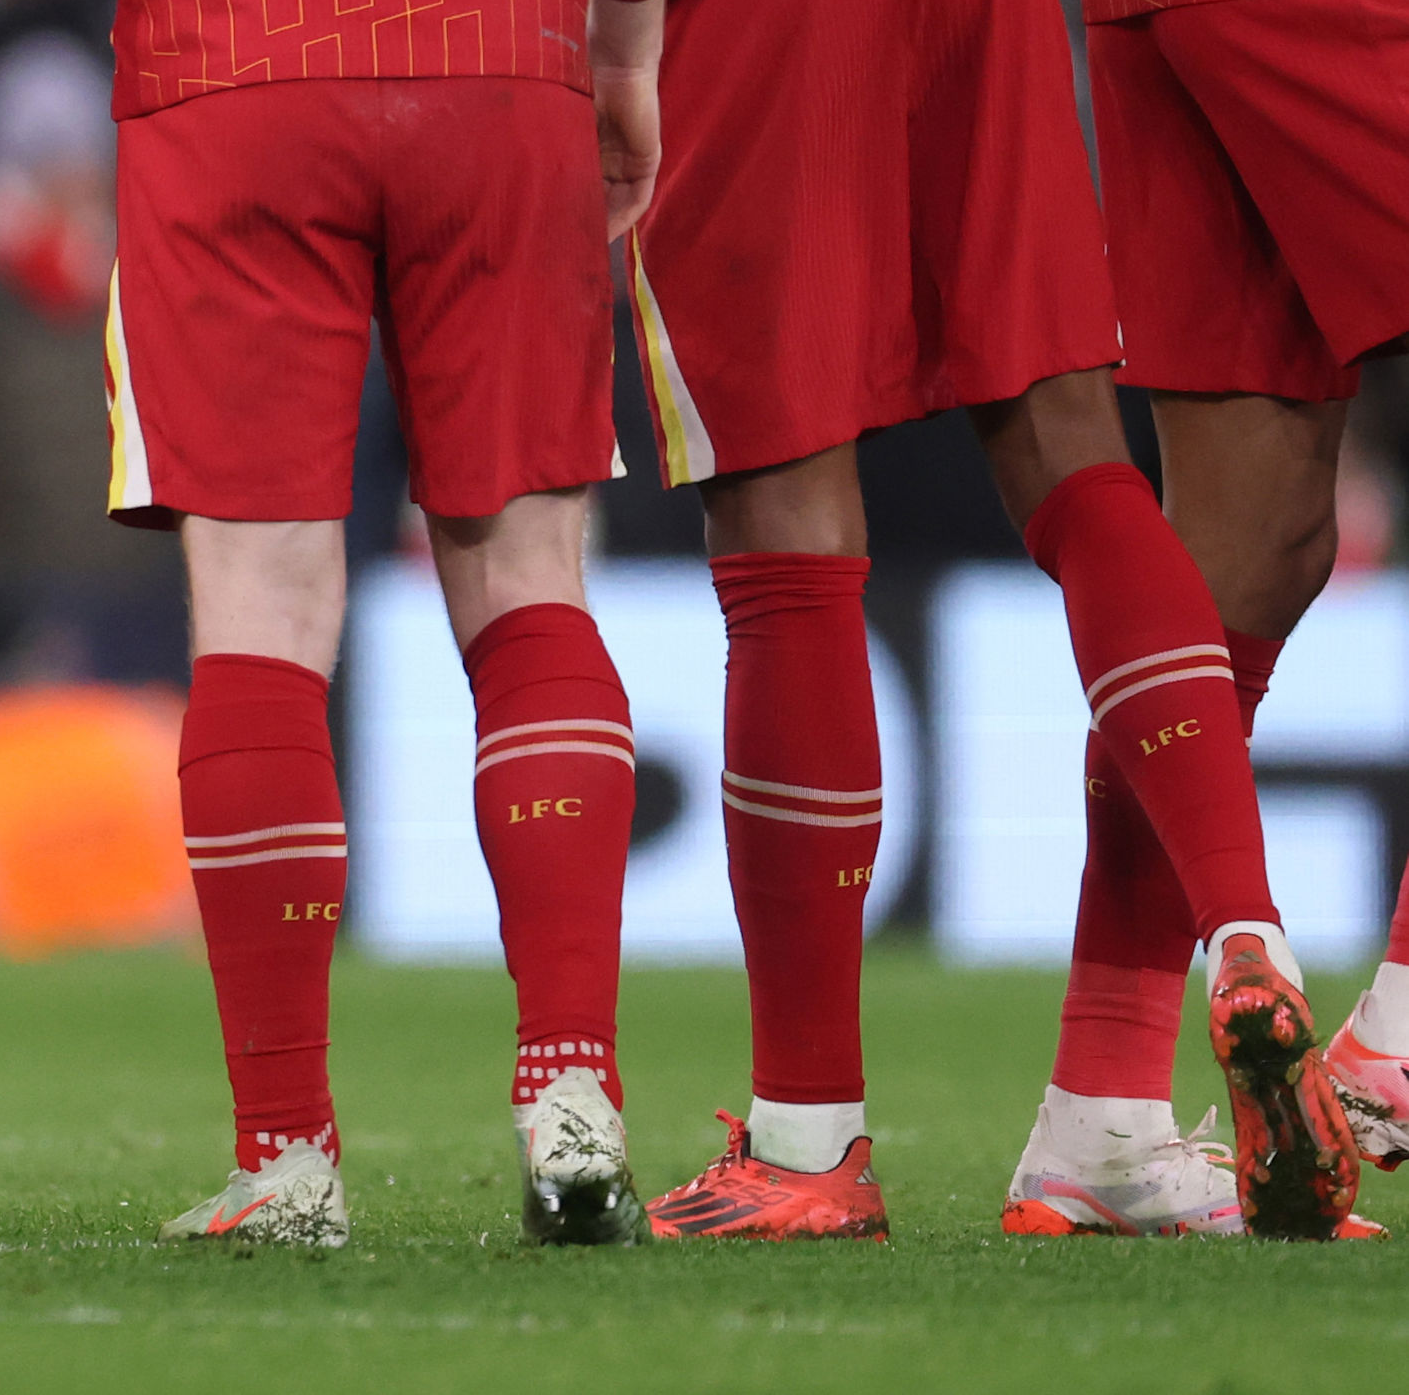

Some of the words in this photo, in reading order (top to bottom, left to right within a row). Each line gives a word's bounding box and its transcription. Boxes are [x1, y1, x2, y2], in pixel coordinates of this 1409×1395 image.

[1138, 718, 1201, 756] LFC
[508, 797, 582, 824] LFC
[282, 902, 340, 921] LFC
